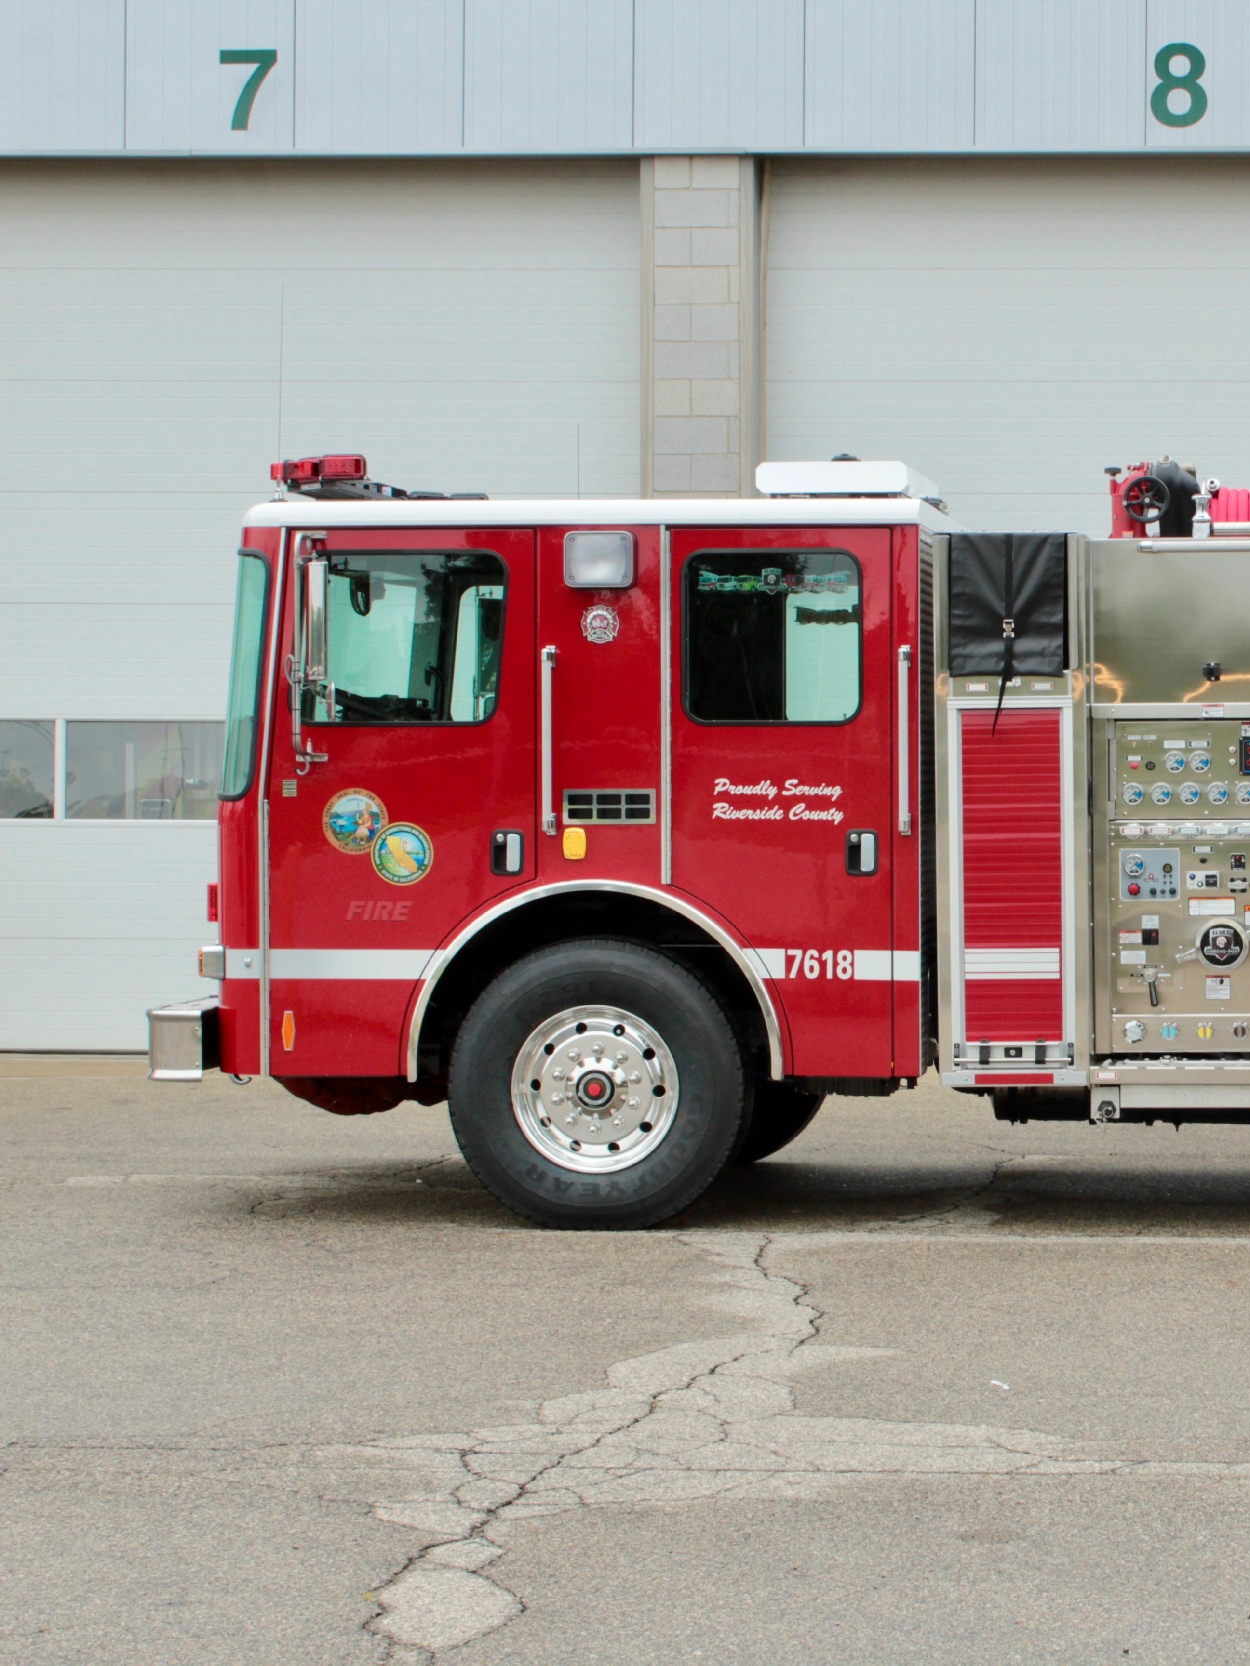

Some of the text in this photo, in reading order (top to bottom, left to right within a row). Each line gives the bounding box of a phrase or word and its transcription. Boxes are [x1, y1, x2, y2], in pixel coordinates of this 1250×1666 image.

[218, 48, 276, 130] 7
[1151, 42, 1207, 126] 8
[713, 777, 843, 800] Proudly Serving
[712, 802, 844, 825] Riverside County
[345, 900, 413, 922] FIRE
[786, 949, 853, 980] 7618
